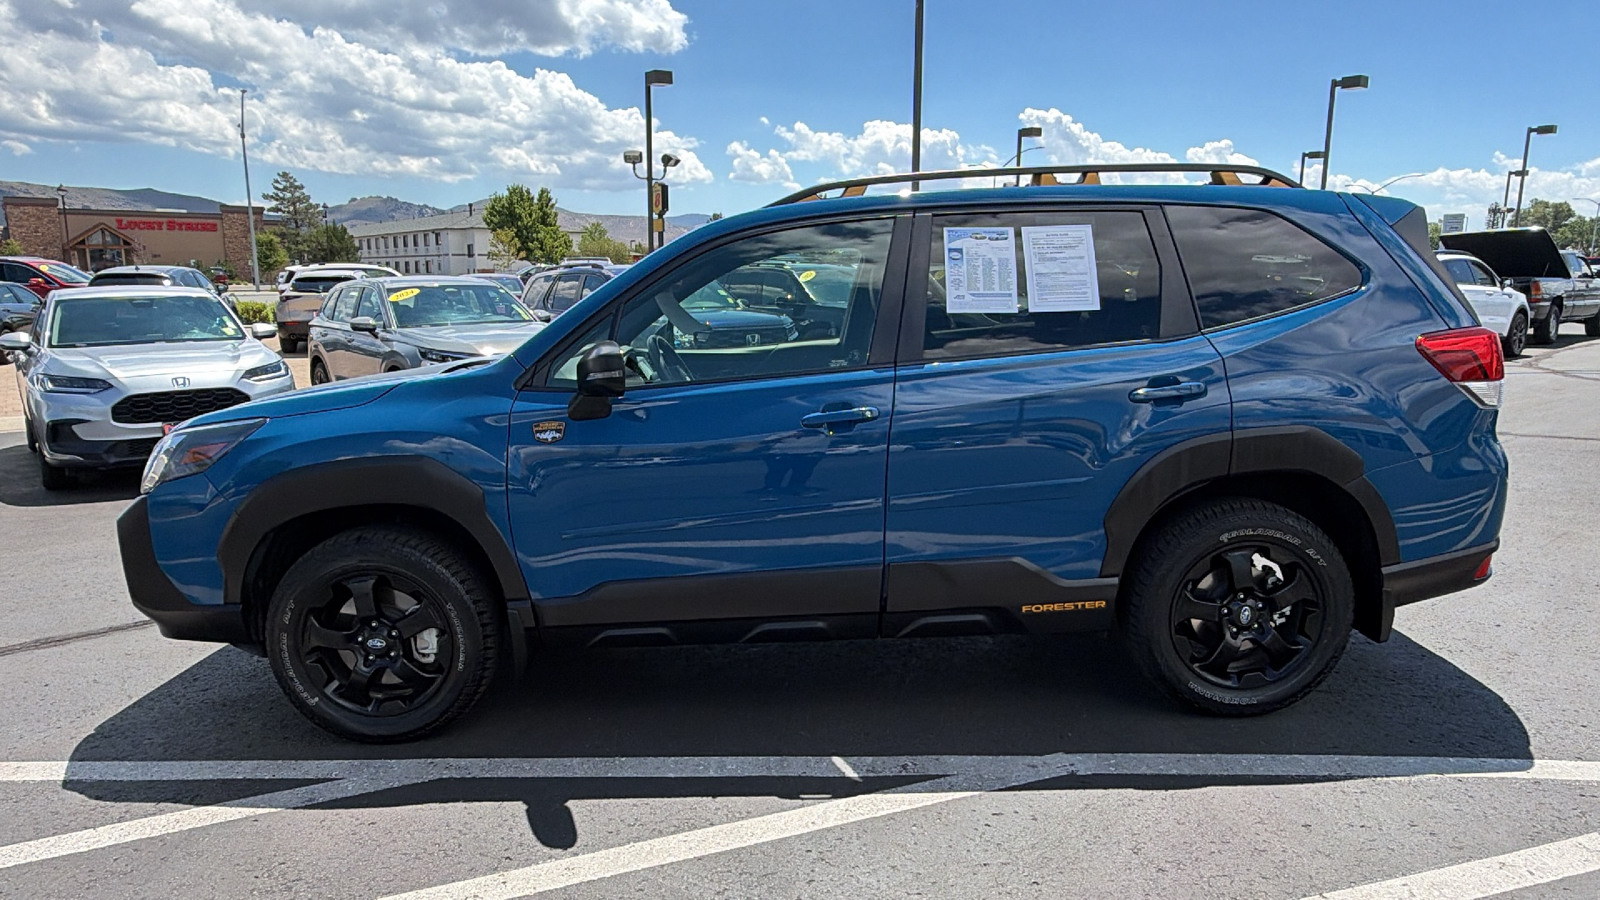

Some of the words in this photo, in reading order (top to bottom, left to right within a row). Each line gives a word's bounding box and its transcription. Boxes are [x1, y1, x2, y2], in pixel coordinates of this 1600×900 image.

[115, 218, 164, 231] LUCKY
[166, 219, 218, 232] STRIKE
[1219, 527, 1302, 546] GEOLANDAR
[1021, 600, 1107, 613] FORESTER
[1187, 681, 1258, 705] YOKOHAMA
